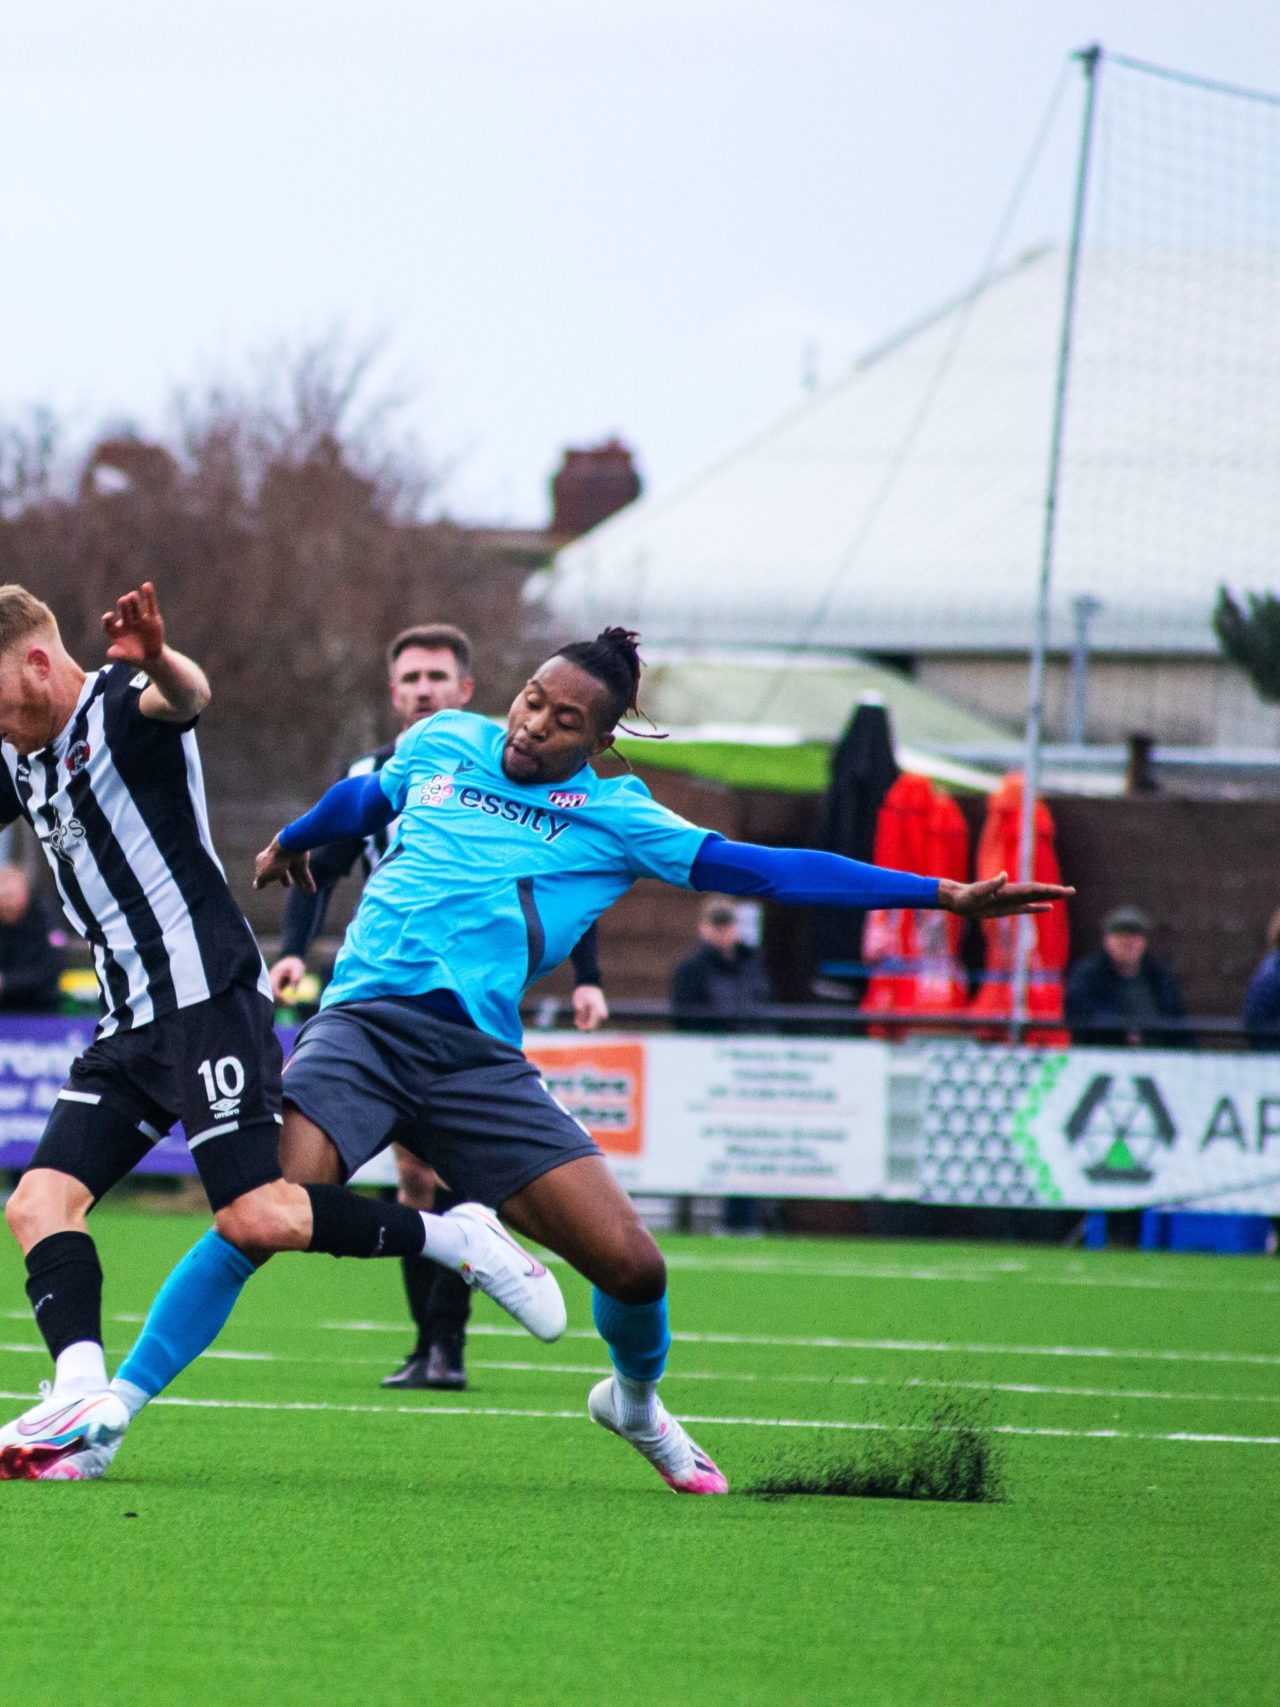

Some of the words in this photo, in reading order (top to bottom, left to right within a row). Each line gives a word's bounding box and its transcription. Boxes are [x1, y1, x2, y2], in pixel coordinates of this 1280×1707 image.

[459, 787, 569, 842] essity
[197, 1055, 245, 1102] 10
[214, 1107, 241, 1120] umbro
